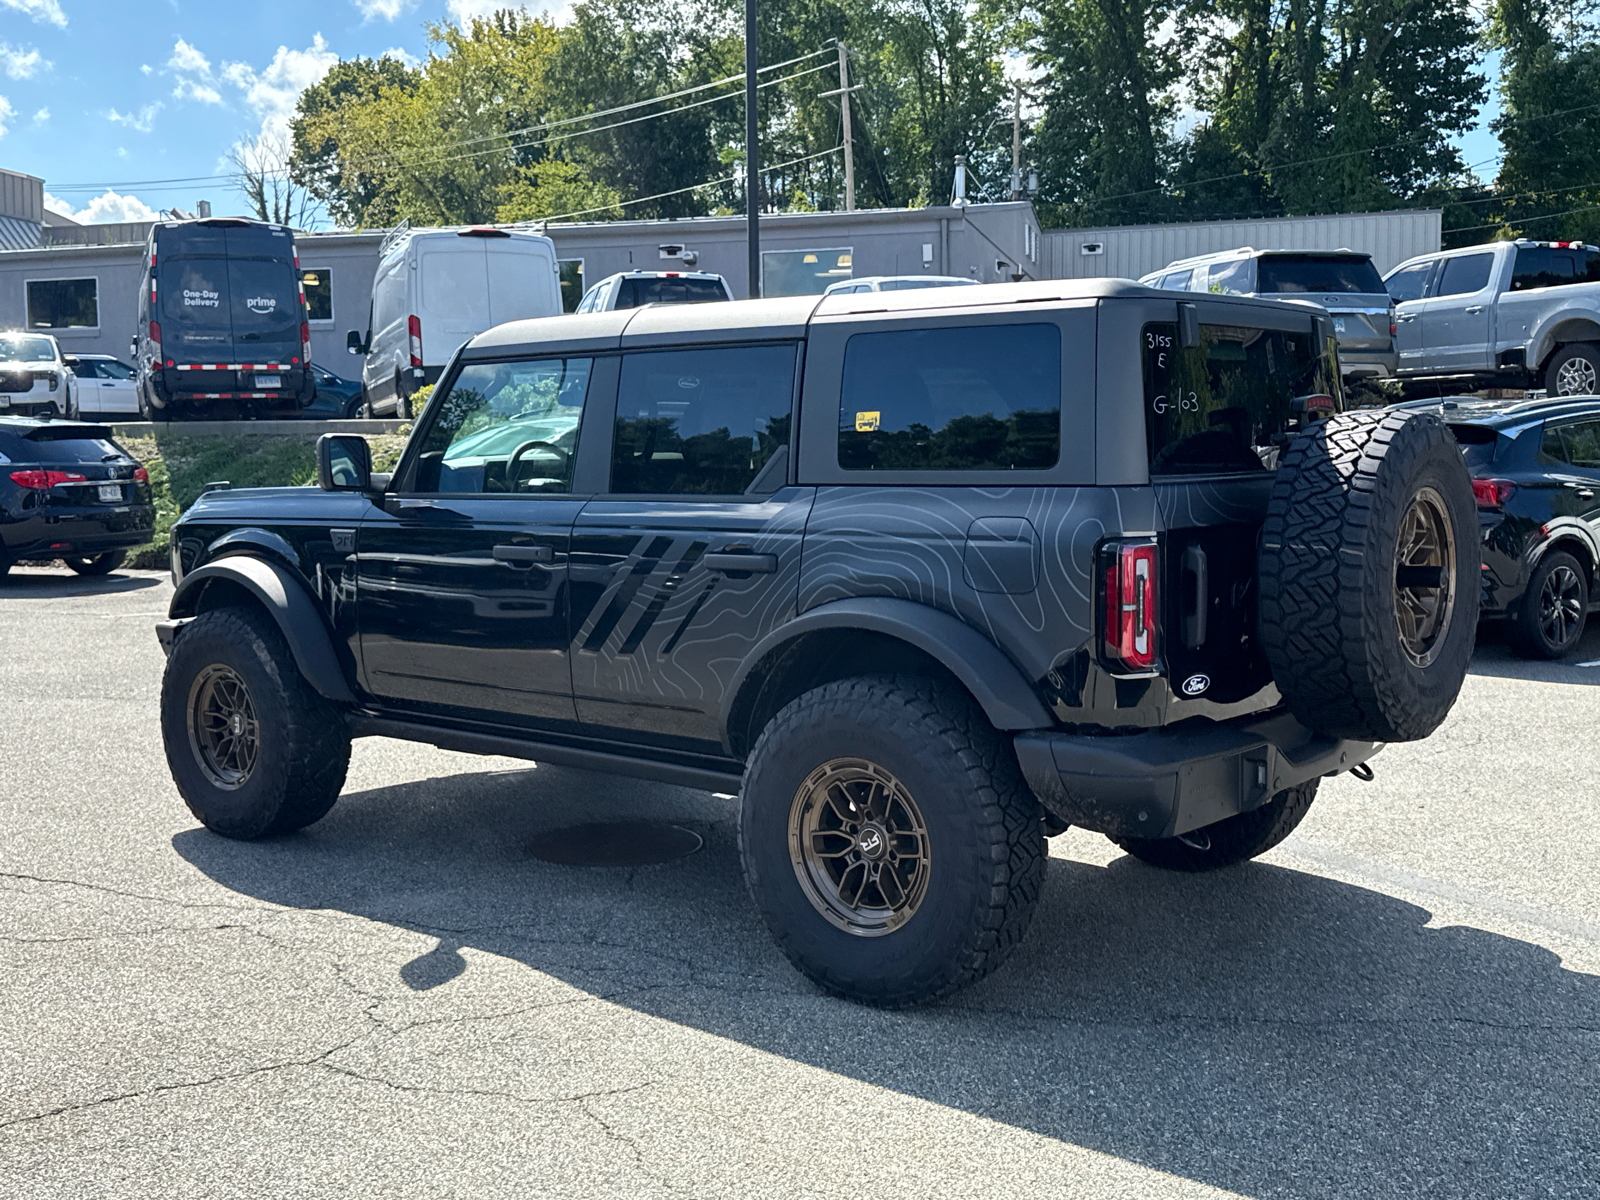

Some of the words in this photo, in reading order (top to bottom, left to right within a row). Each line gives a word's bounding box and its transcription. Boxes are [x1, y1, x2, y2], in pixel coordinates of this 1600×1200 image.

[183, 290, 219, 299] One-Day
[184, 298, 219, 308] Delivery
[247, 297, 276, 308] prime
[1146, 333, 1172, 349] 3155
[1157, 352, 1167, 369] E
[1187, 677, 1206, 692] Ford
